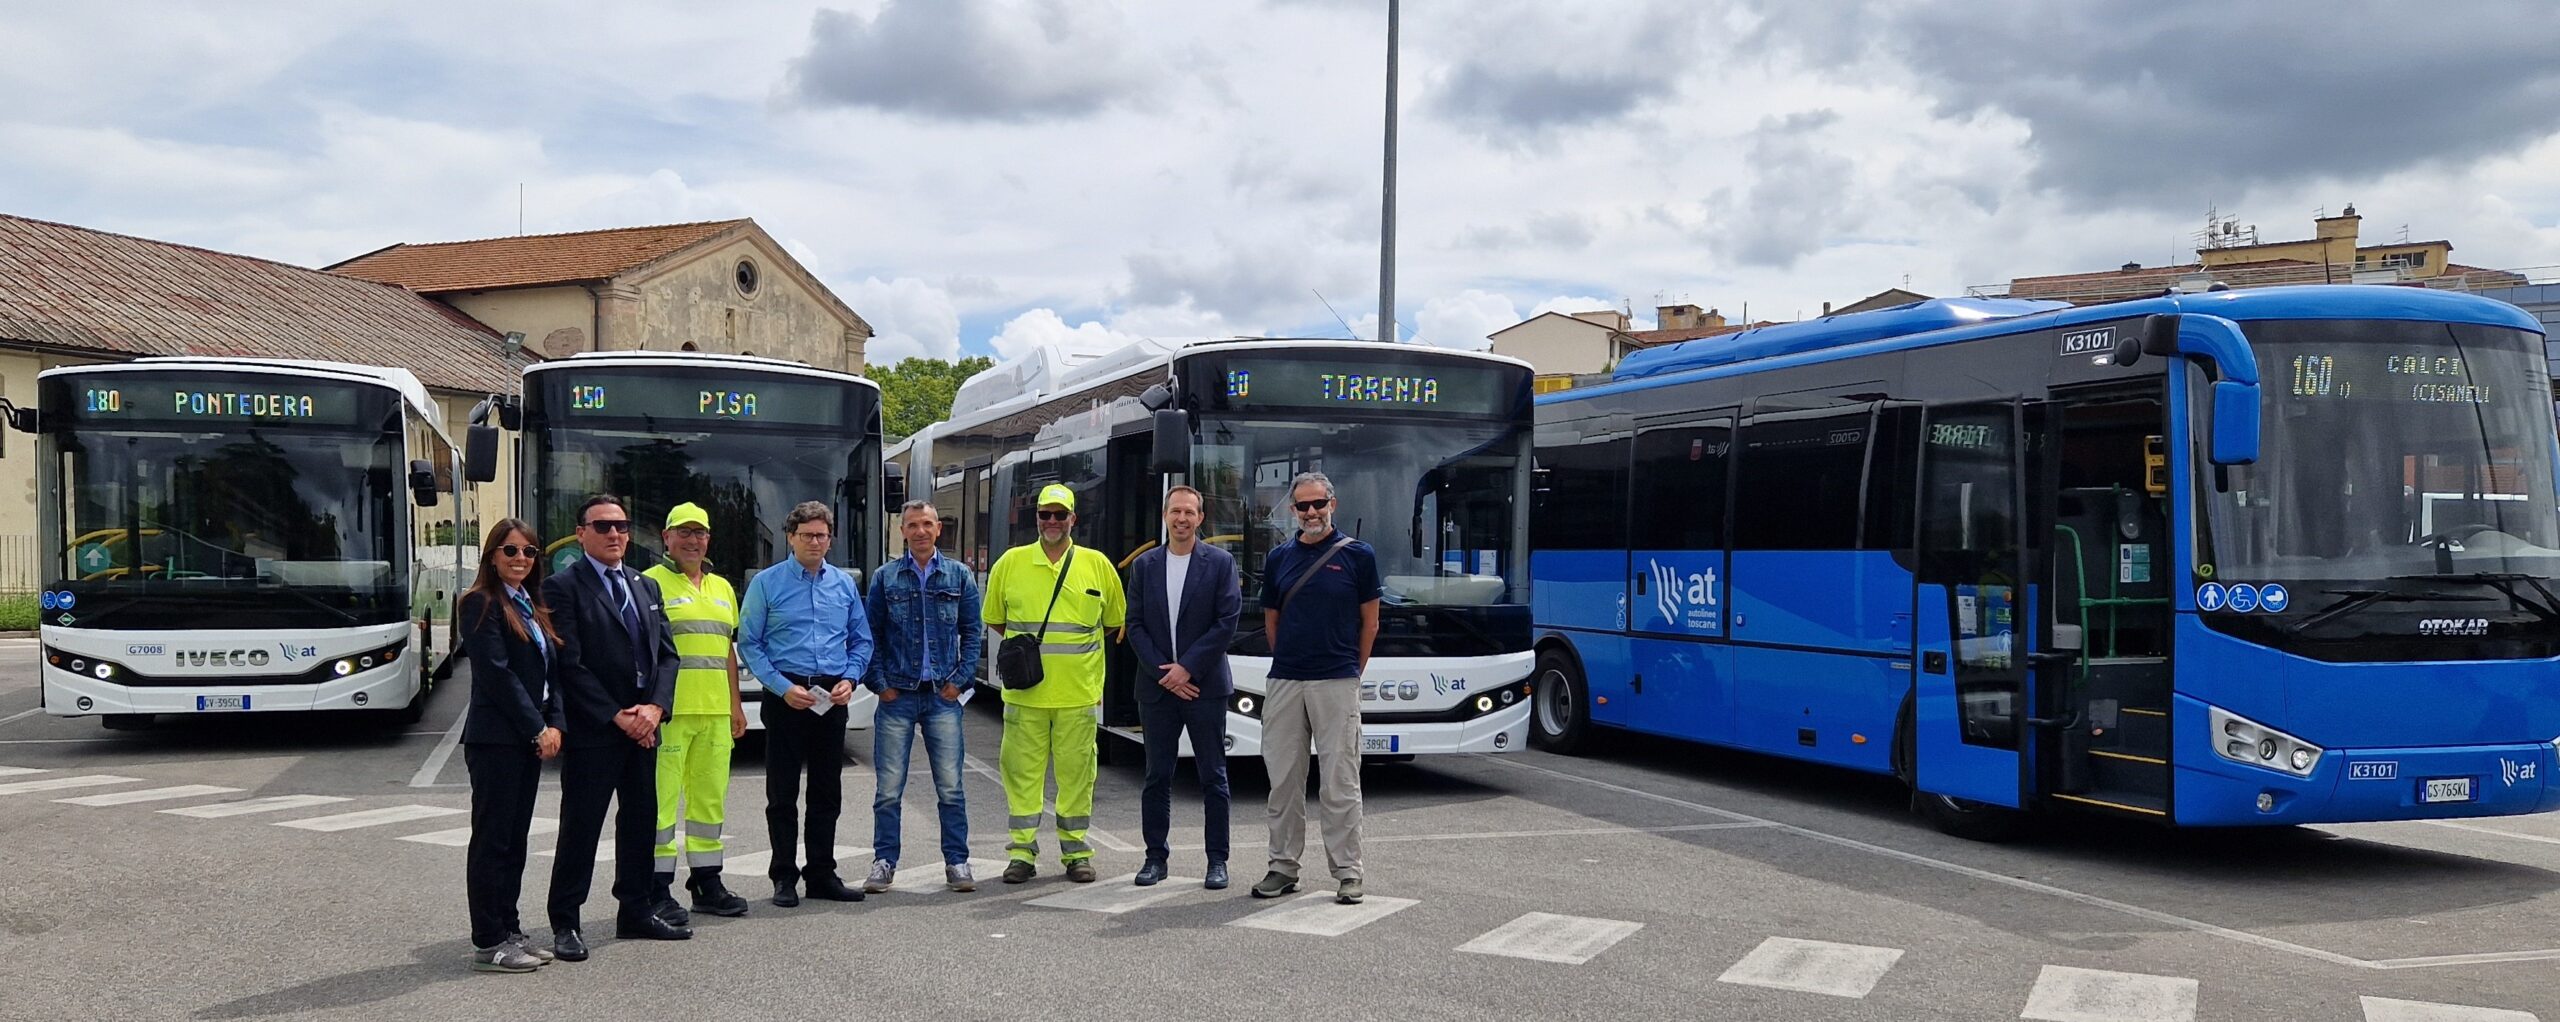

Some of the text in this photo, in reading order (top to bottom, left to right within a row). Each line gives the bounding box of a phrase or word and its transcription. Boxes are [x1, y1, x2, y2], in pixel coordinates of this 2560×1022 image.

[2066, 331, 2109, 352] K3101
[2387, 355, 2461, 375] CALCI
[2292, 355, 2333, 396] 160
[572, 385, 606, 409] 150
[1321, 374, 1438, 403] TIRRENIA
[86, 389, 121, 413] 180
[174, 391, 314, 417] PONTEDERA
[699, 391, 757, 416] PISA
[1687, 566, 1717, 606] at
[1687, 608, 1717, 618] autolinee
[1687, 618, 1717, 629] toscane
[2418, 618, 2489, 636] OTOKAR
[128, 645, 164, 655] G7008
[175, 648, 271, 668] IVECO
[300, 645, 317, 657] at
[1360, 680, 1420, 701] ECO
[1450, 677, 1466, 690] at
[2352, 764, 2393, 777] K3101
[2519, 761, 2536, 779] at
